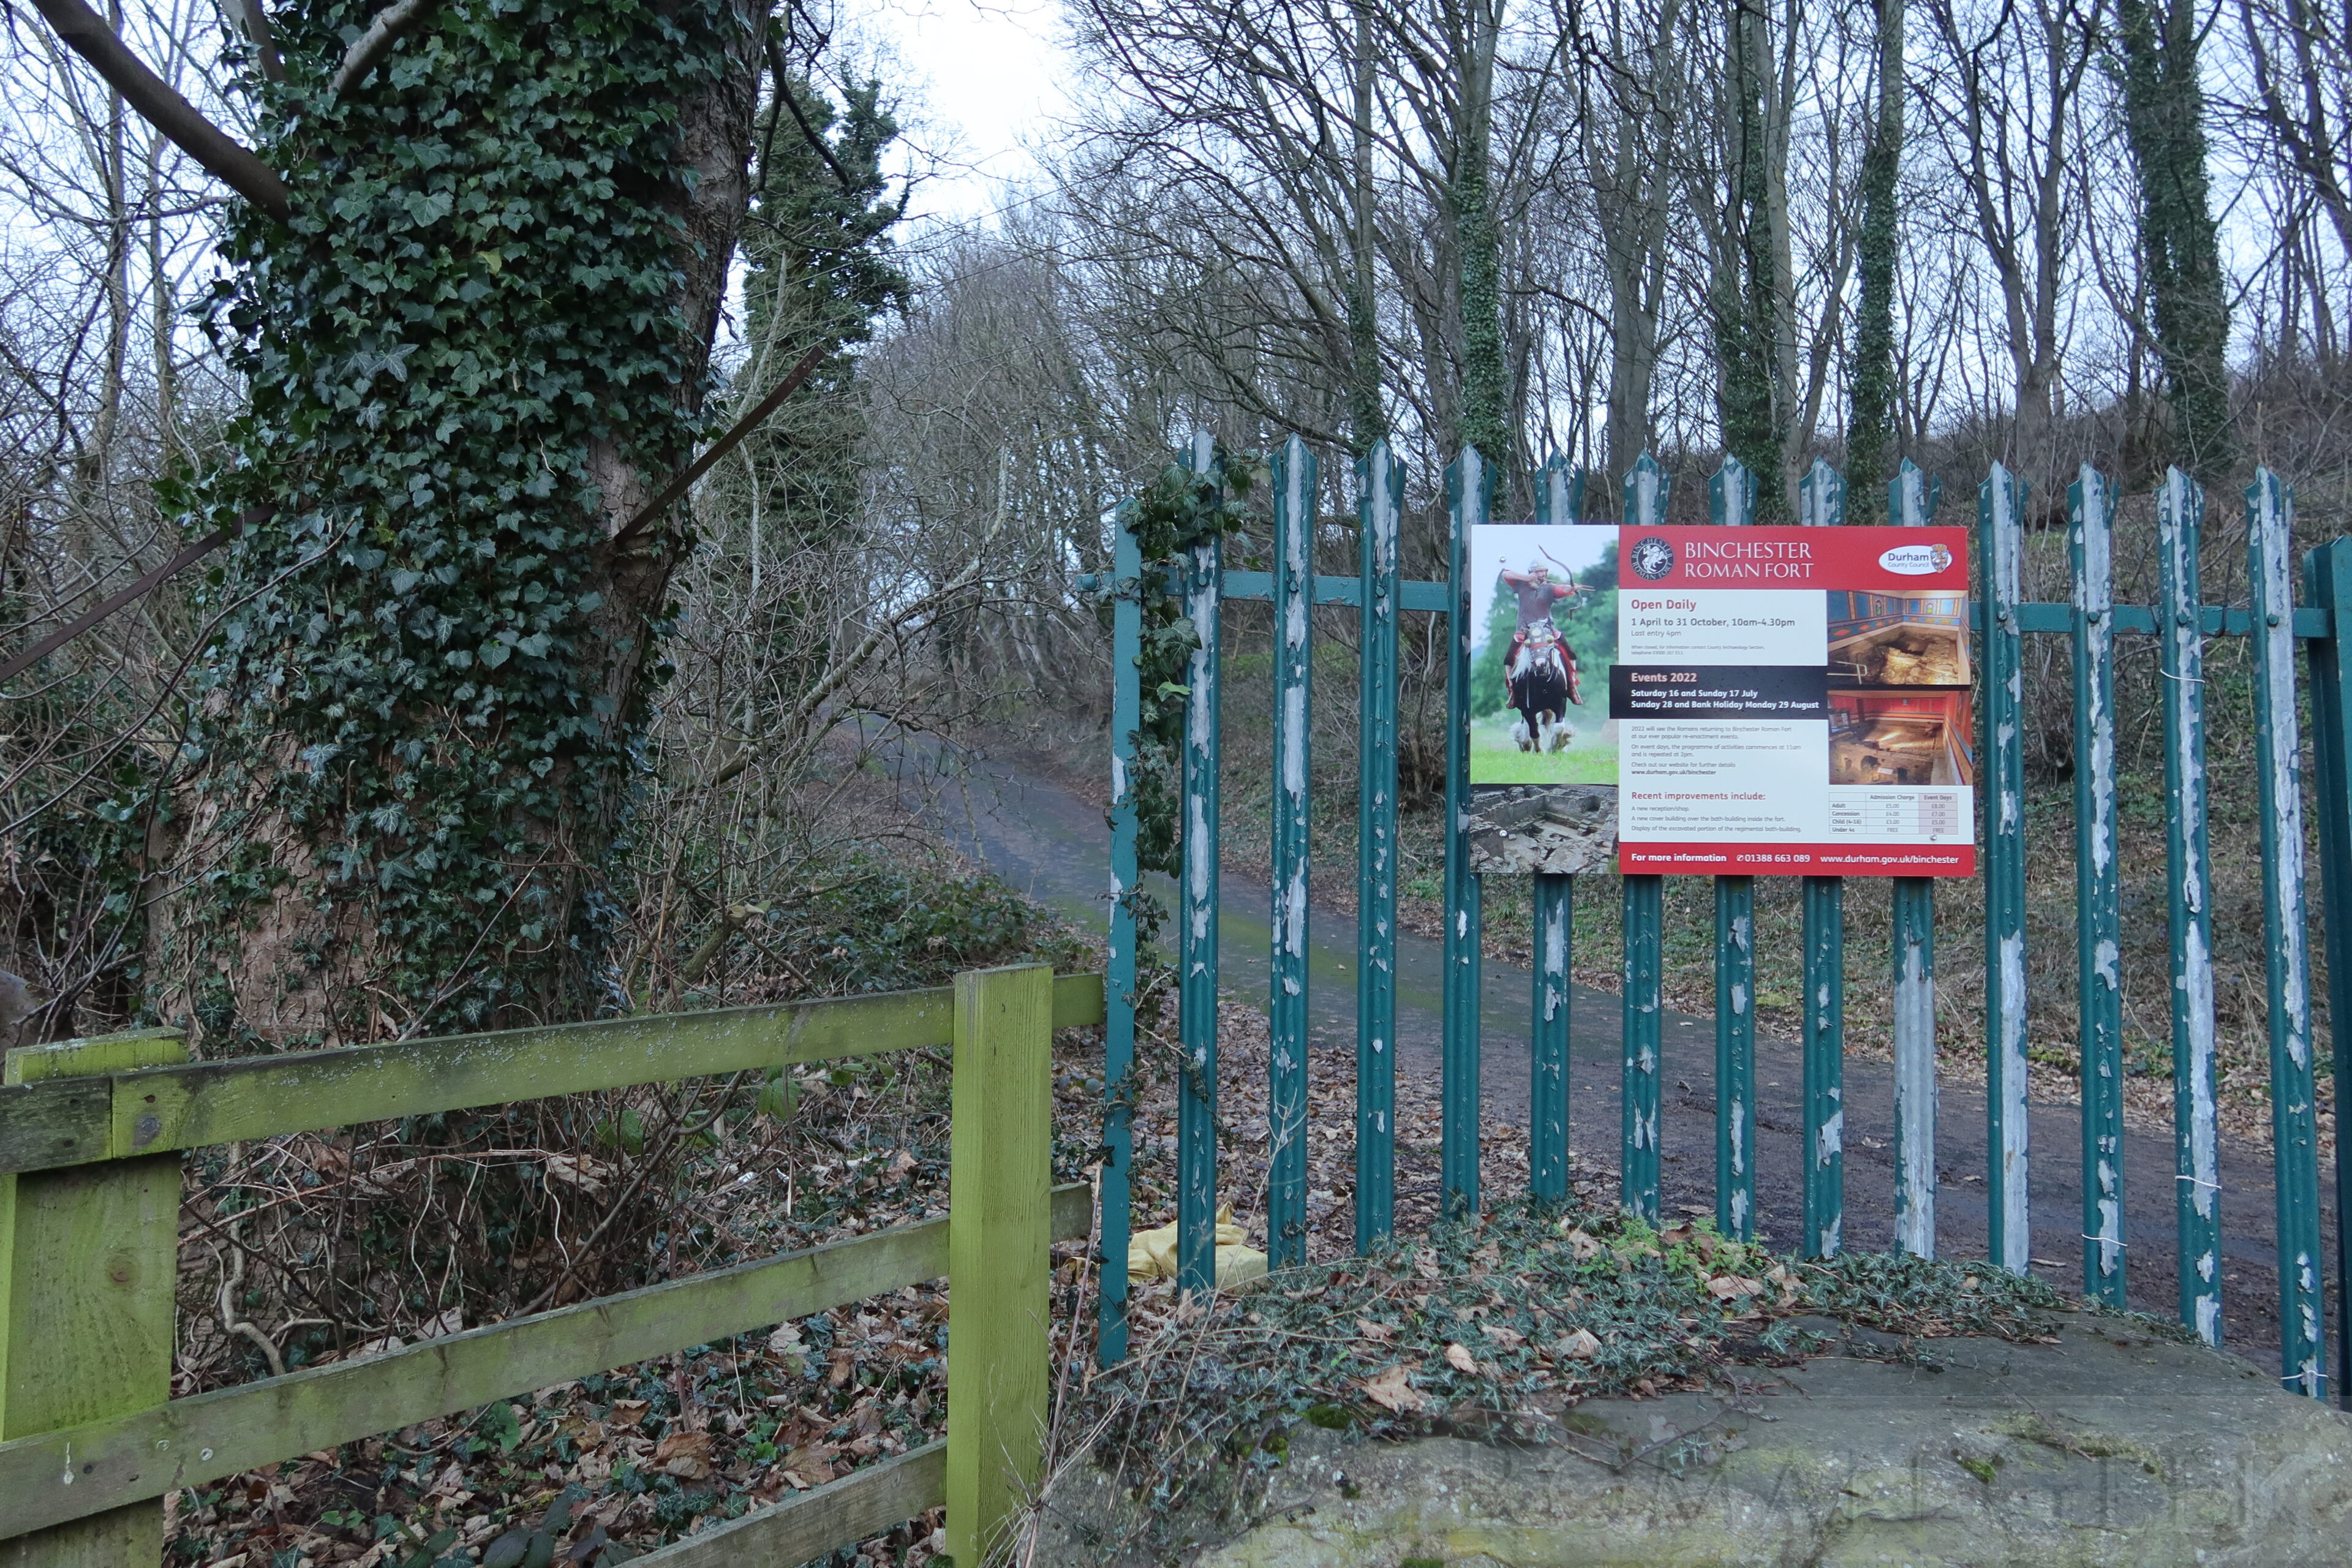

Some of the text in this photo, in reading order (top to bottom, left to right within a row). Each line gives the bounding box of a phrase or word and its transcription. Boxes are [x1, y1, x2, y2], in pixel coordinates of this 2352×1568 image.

[1686, 542, 1811, 559] BINCHESTER
[1686, 563, 1814, 578] ROMAN FORT
[1632, 599, 1696, 612] Open Daily
[1640, 618, 1661, 627] April
[1691, 618, 1728, 627] October,
[1632, 673, 1697, 682] Events 2022
[1631, 689, 1667, 698] Saturday
[1698, 690, 1728, 698] Sunday
[1741, 690, 1758, 699] July
[1631, 701, 1660, 709] Sunday
[1713, 701, 1743, 710] Holiday
[1745, 701, 1777, 710] Monday
[1790, 701, 1819, 710] August
[1665, 792, 1728, 801] improvements
[1820, 855, 1959, 865] www.durham.gov.uk/binchester
